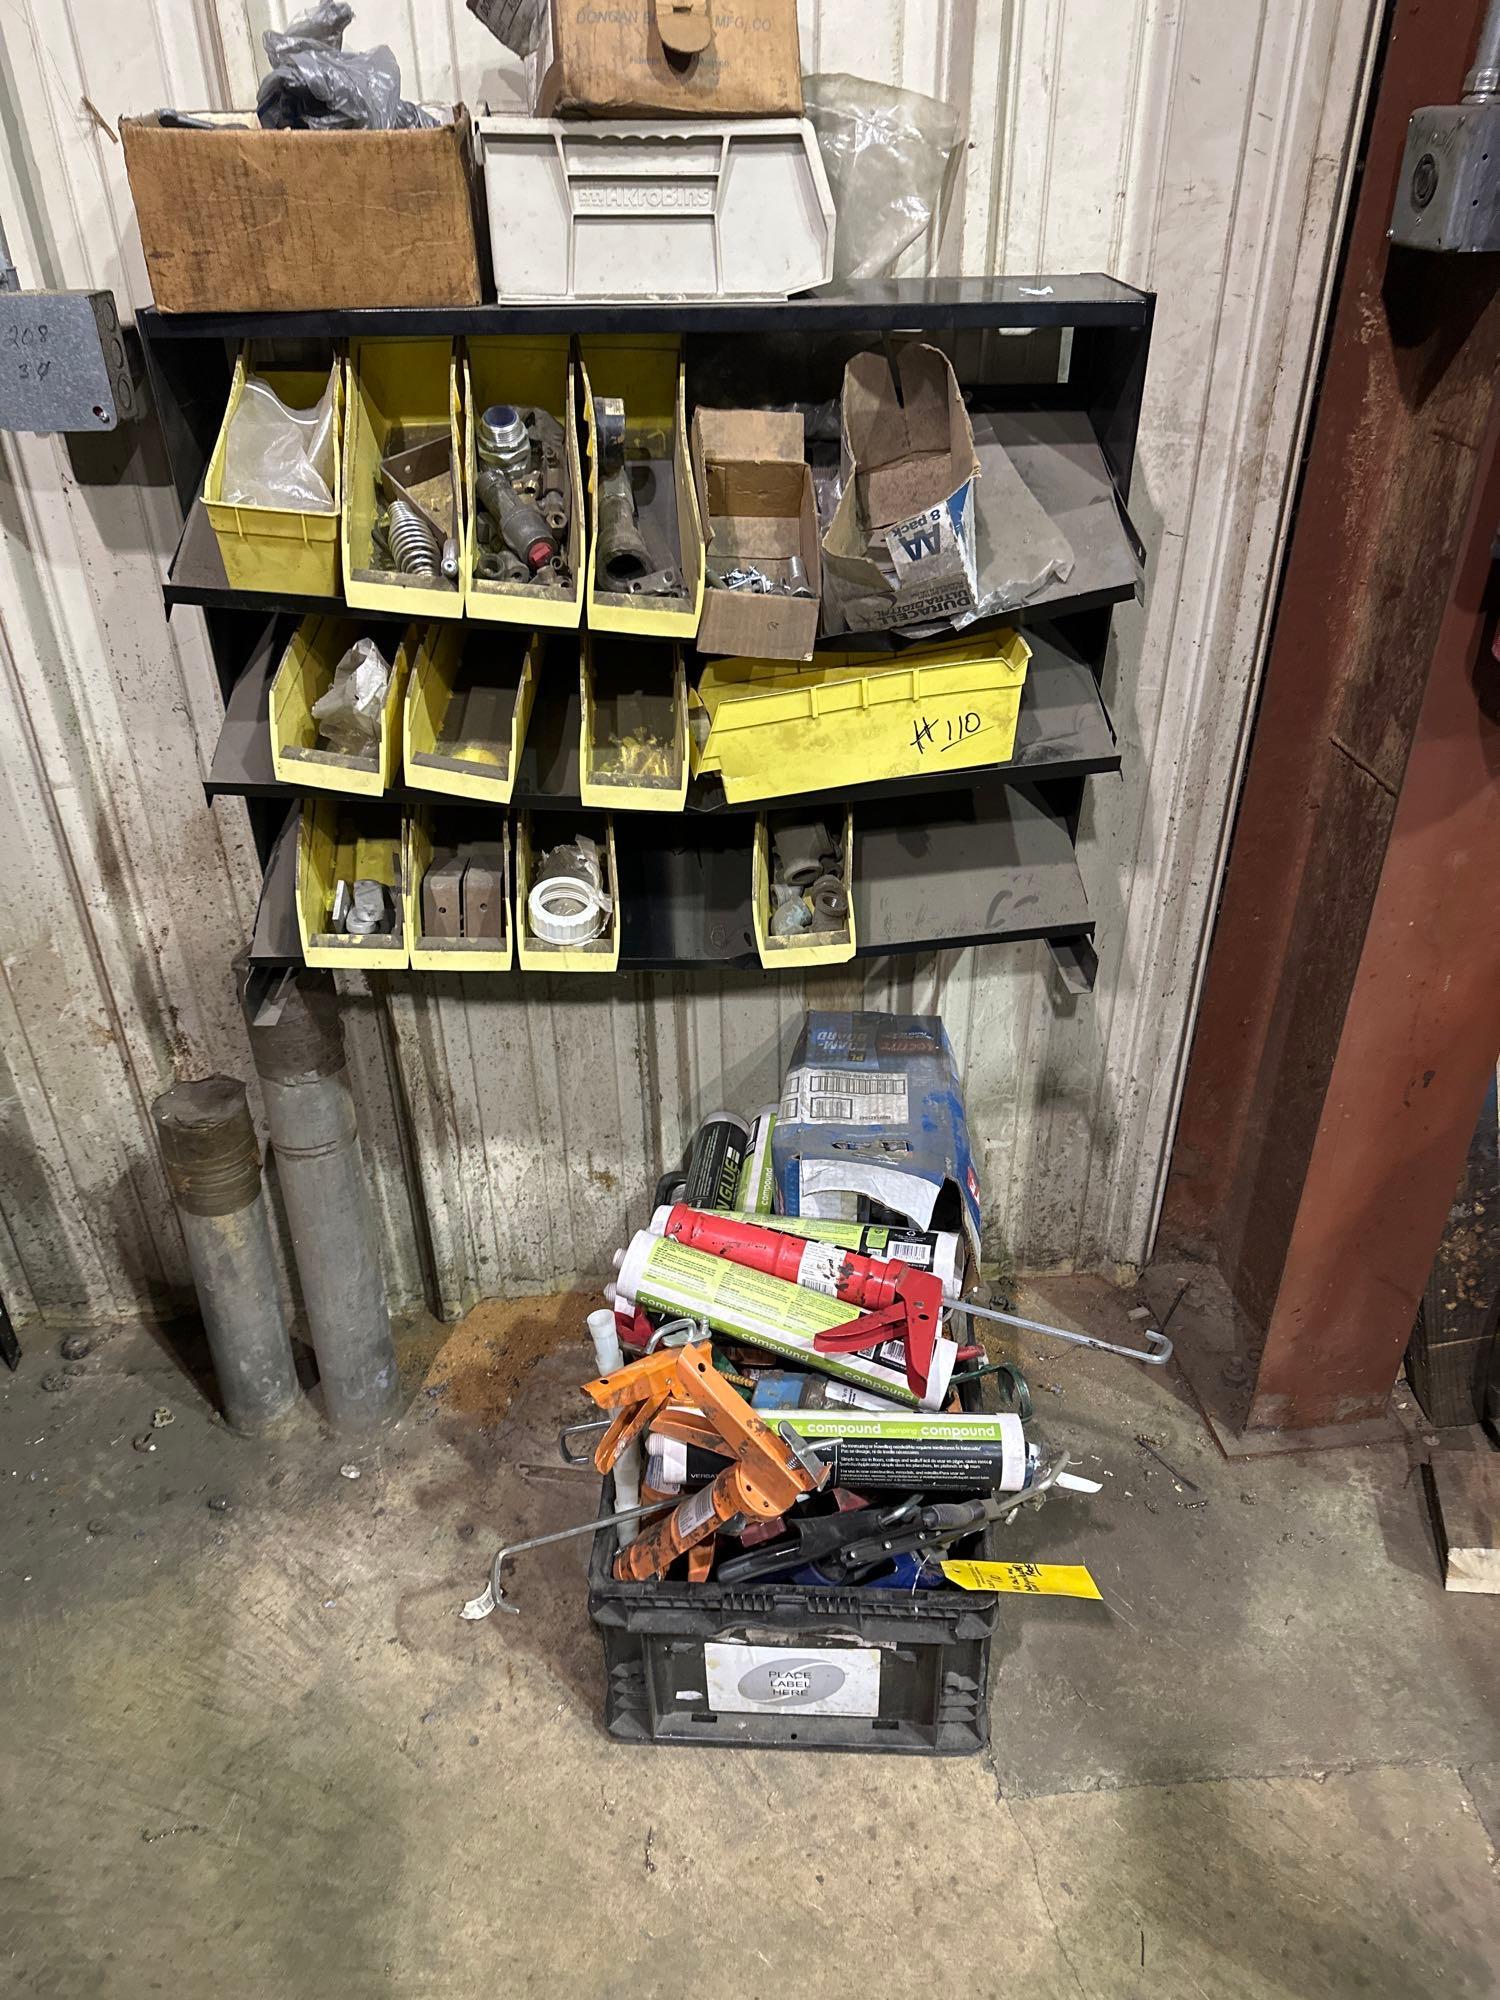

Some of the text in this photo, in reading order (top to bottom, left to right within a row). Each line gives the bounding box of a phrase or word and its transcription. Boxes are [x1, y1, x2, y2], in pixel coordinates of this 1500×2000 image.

[576, 10, 638, 25] DONGAN
[891, 508, 941, 539] 8 pack
[898, 522, 942, 563] AA
[924, 589, 969, 605] ULTRA
[874, 600, 923, 618] DIGITAL
[876, 597, 972, 625] DURACELL
[761, 1167, 773, 1206] compound
[741, 1333, 809, 1363] compound
[844, 1370, 914, 1400] compound
[807, 1423, 881, 1435] compound
[920, 1425, 996, 1437] compound
[768, 1670, 812, 1680] PLACE
[770, 1680, 811, 1689] LABEL
[772, 1689, 809, 1697] HERE
